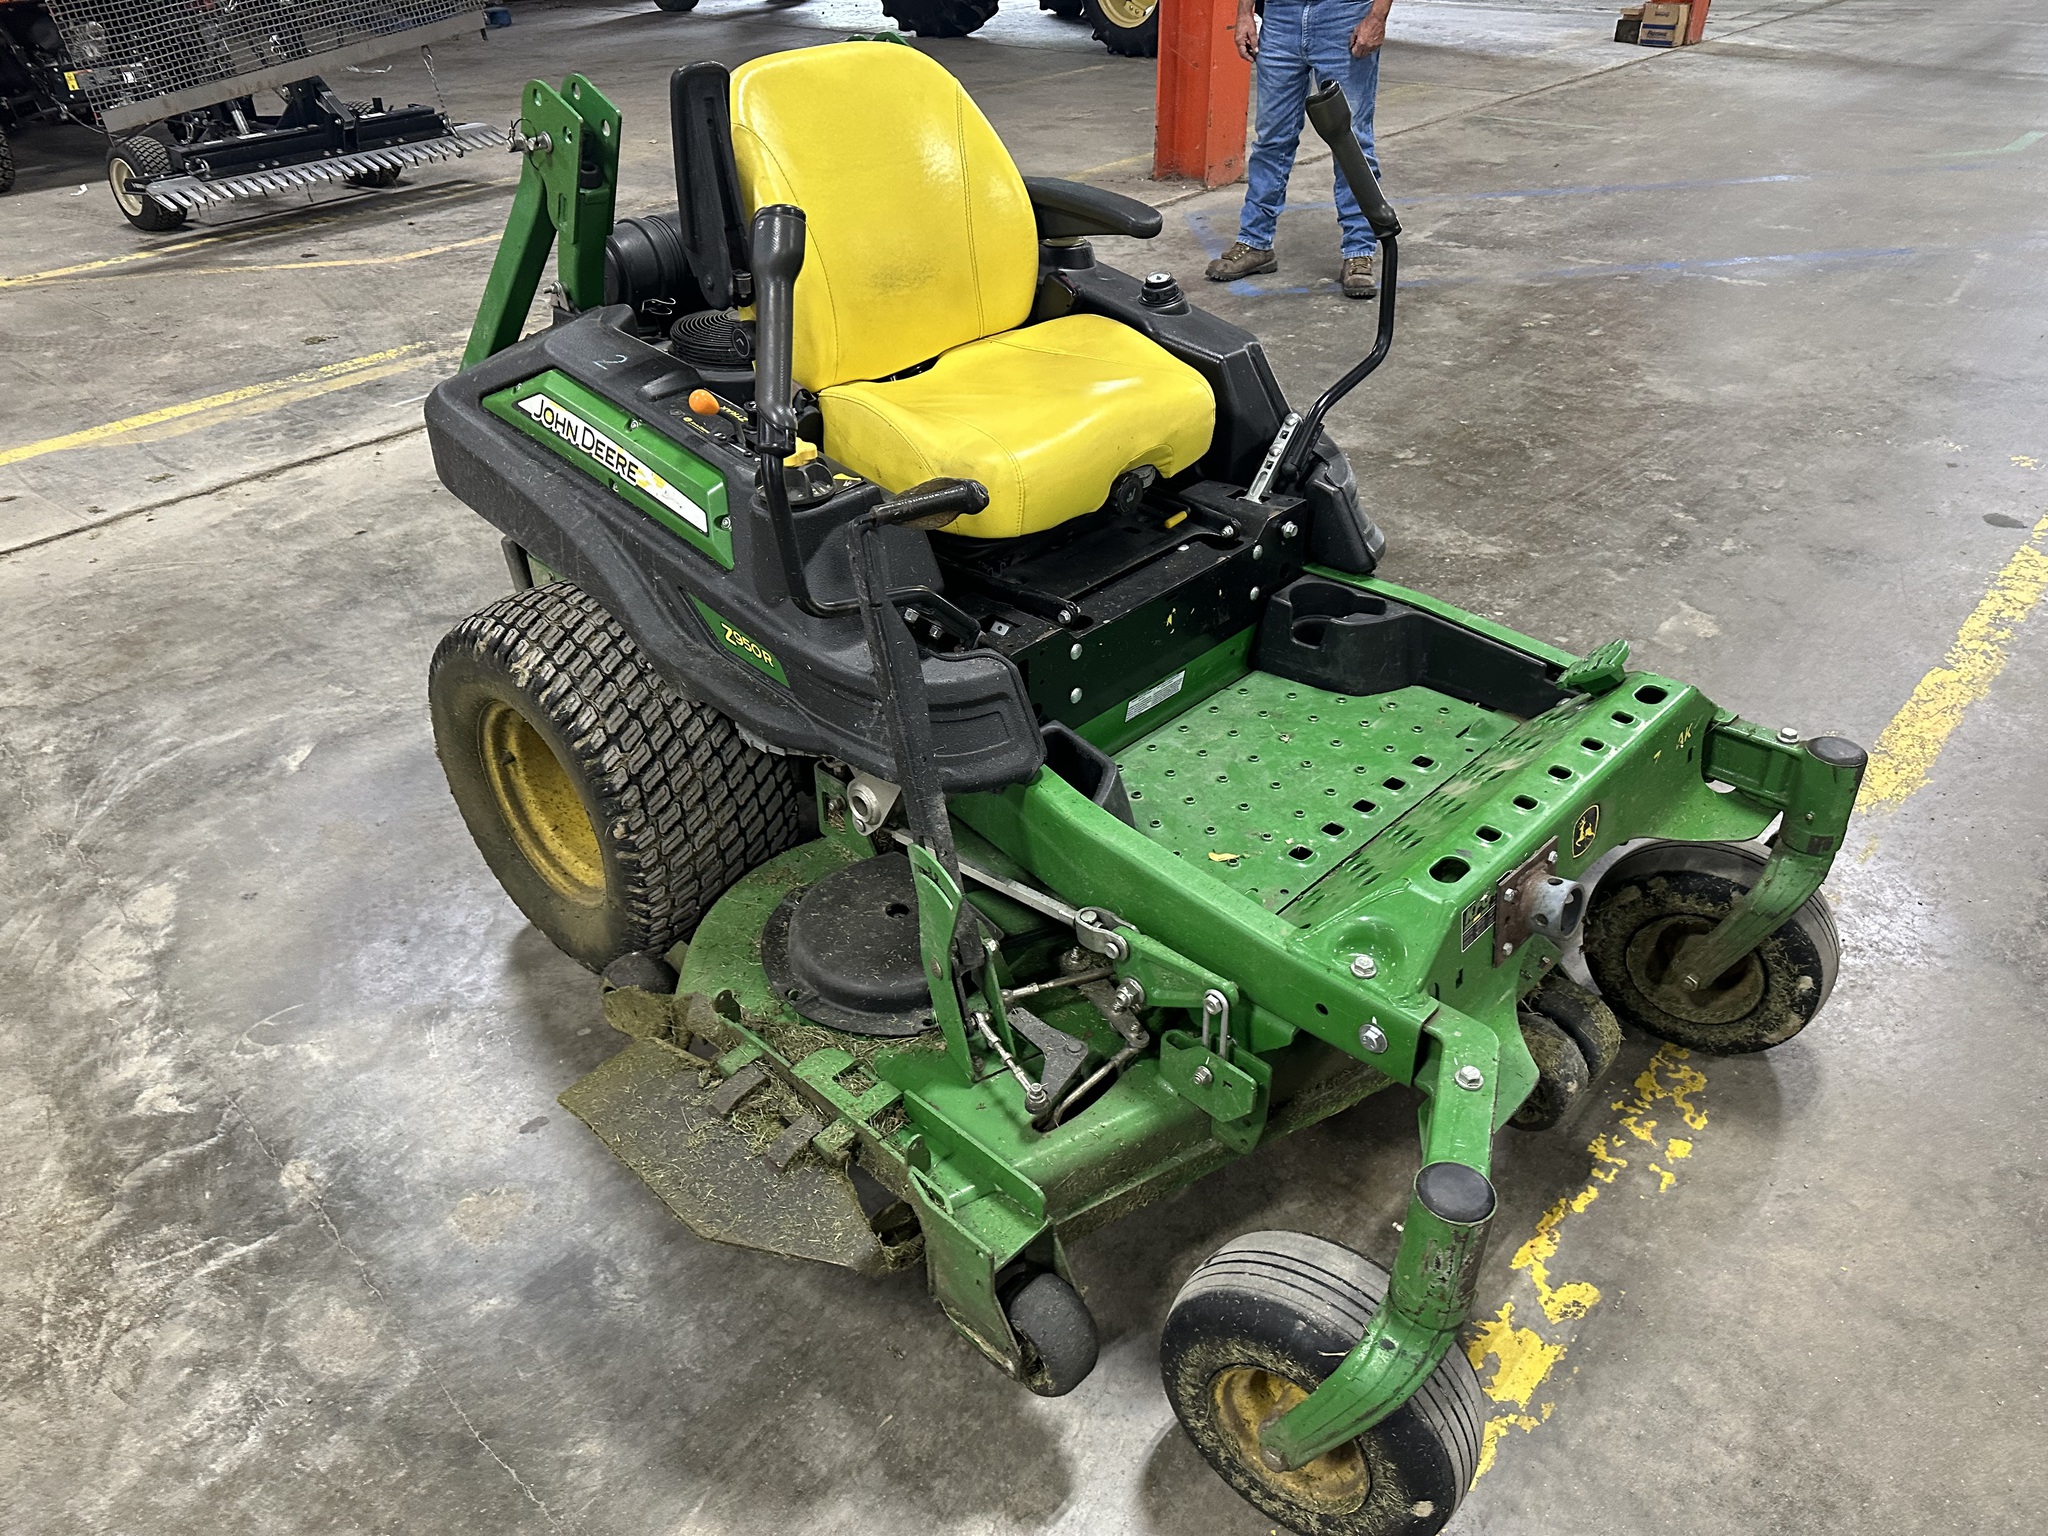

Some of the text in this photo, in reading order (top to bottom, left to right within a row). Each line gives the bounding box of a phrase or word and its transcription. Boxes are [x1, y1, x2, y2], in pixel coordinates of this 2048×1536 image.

[533, 398, 639, 483] JOHN DEERE
[720, 622, 776, 668] Z950R
